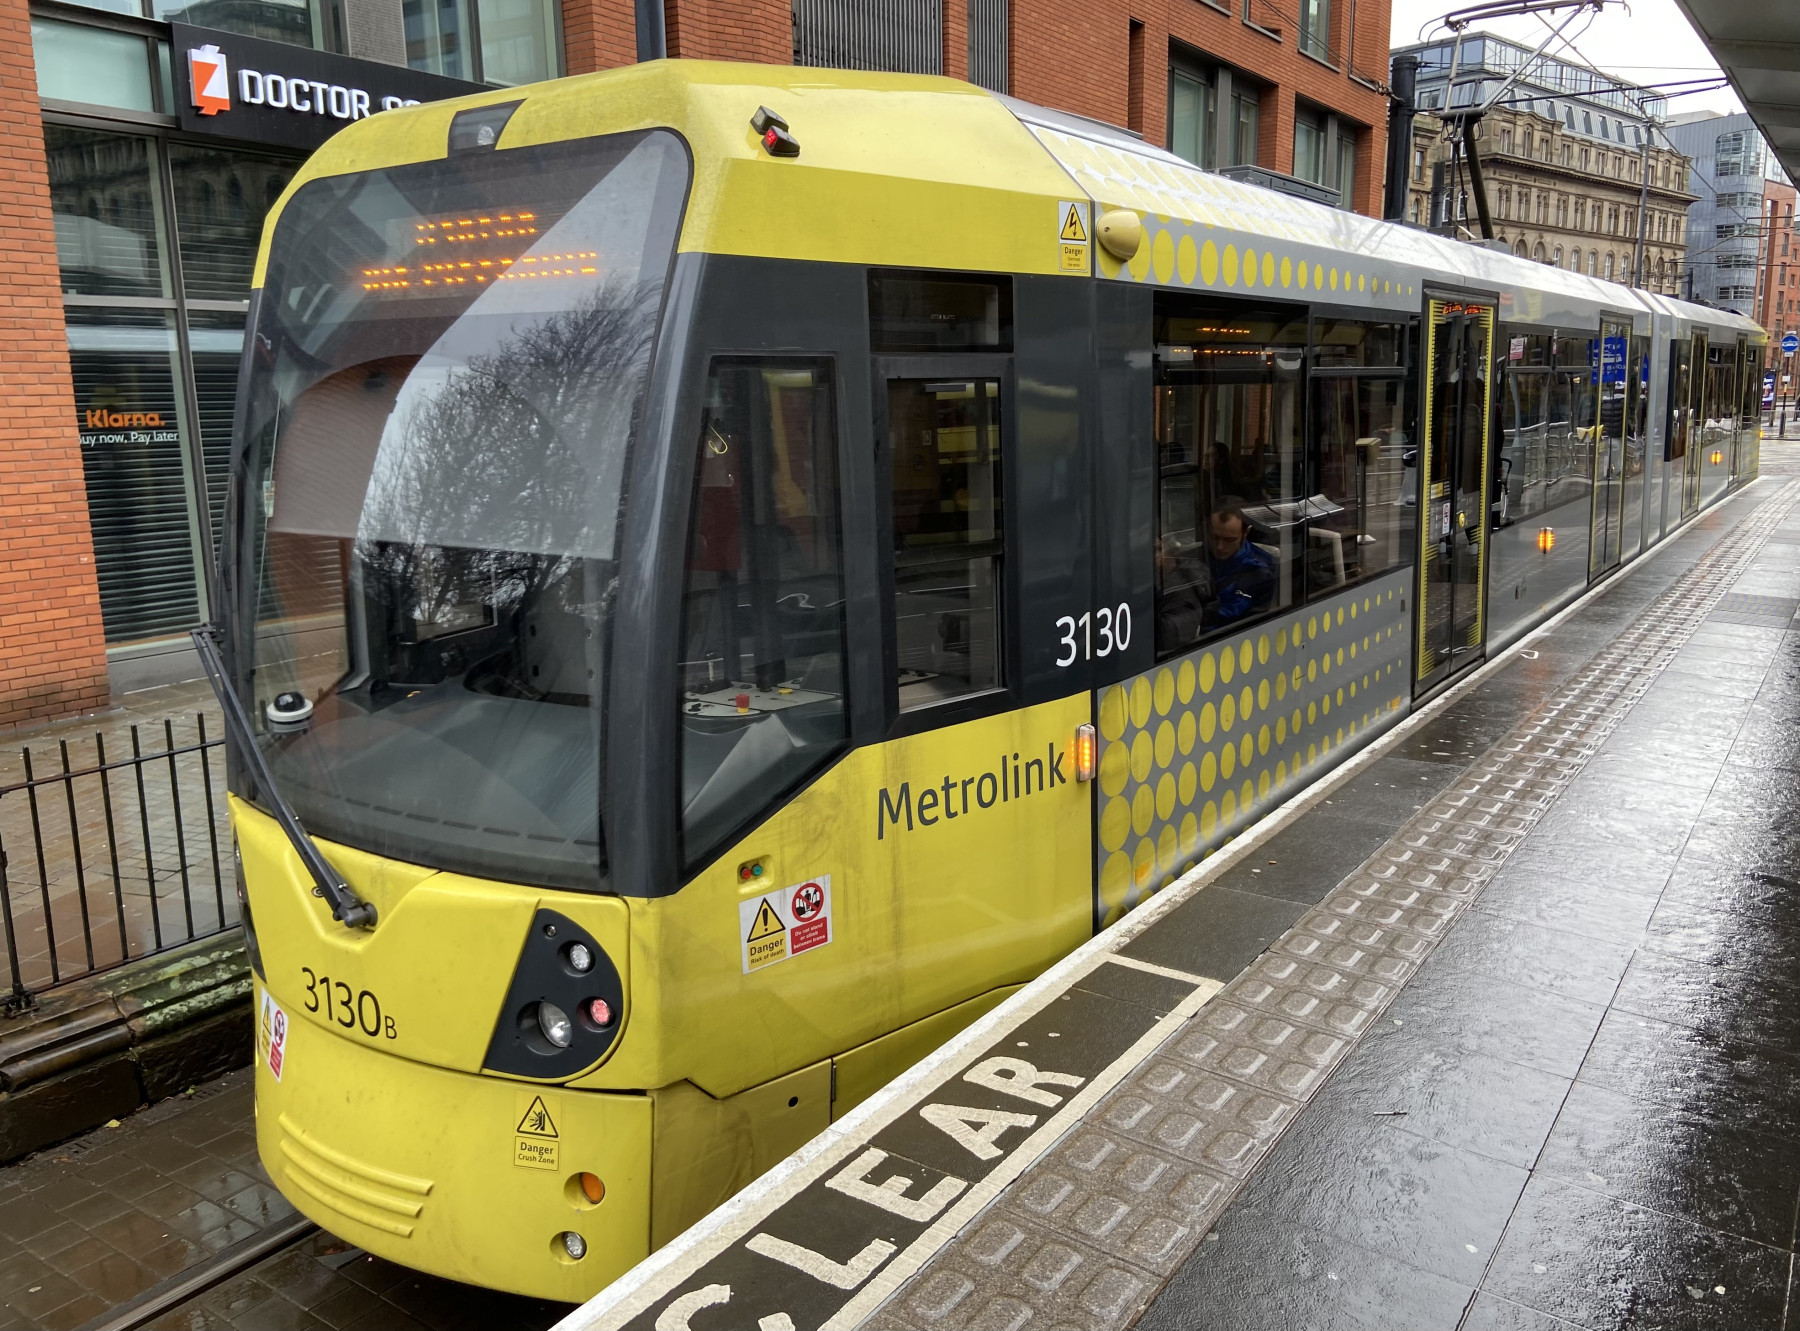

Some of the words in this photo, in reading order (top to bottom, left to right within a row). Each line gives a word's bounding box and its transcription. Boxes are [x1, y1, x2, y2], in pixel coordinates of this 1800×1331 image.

[238, 69, 370, 120] DOCTOR
[1064, 246, 1083, 256] Danger
[86, 409, 165, 428] Klarna.
[100, 434, 127, 444] now,
[130, 431, 151, 445] Pay
[153, 431, 179, 441] later
[1055, 602, 1131, 667] 3130
[877, 742, 1067, 840] Metrolink
[749, 938, 784, 957] Danger
[750, 955, 762, 964] Risk
[770, 949, 784, 957] death
[520, 1142, 554, 1155] Danger
[518, 1153, 537, 1162] Crush
[538, 1155, 555, 1165] Zone
